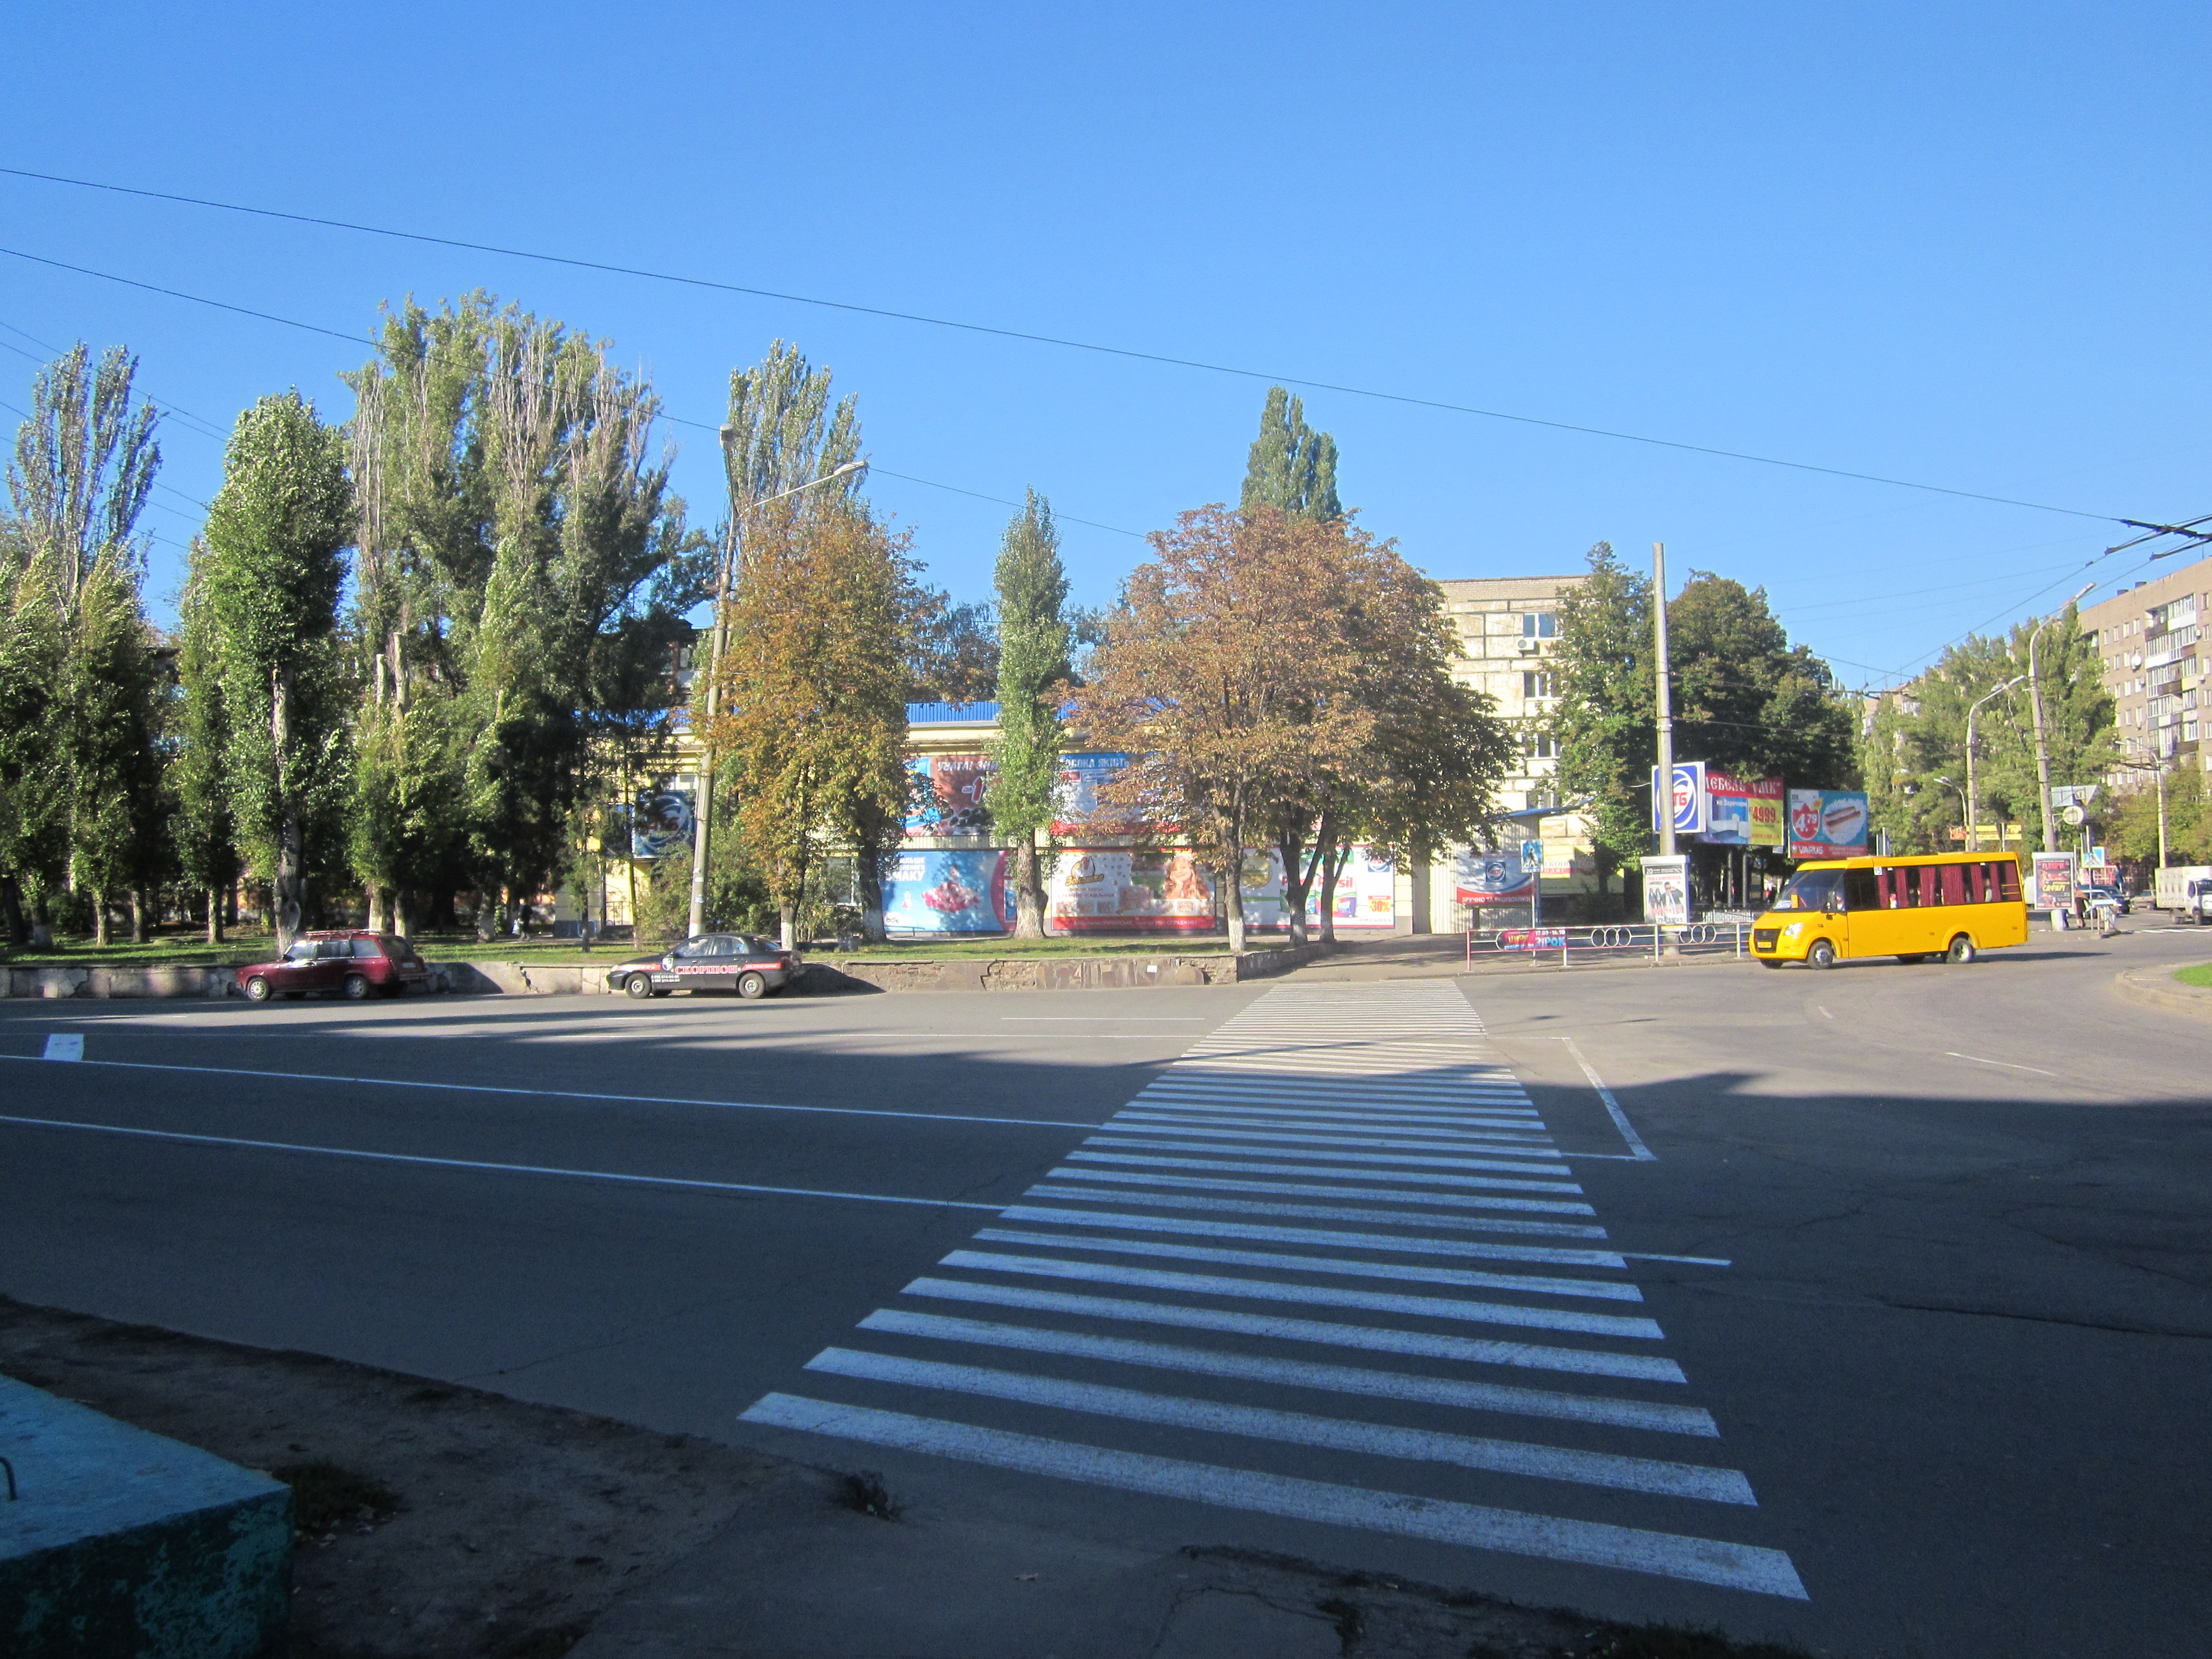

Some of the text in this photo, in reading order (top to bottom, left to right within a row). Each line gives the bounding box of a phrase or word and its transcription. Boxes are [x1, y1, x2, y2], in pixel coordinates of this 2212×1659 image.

[937, 761, 973, 771] УВАГА!
[1673, 792, 1688, 806] ТБ
[1752, 806, 1776, 823] 4999
[1370, 900, 1390, 912] -30%
